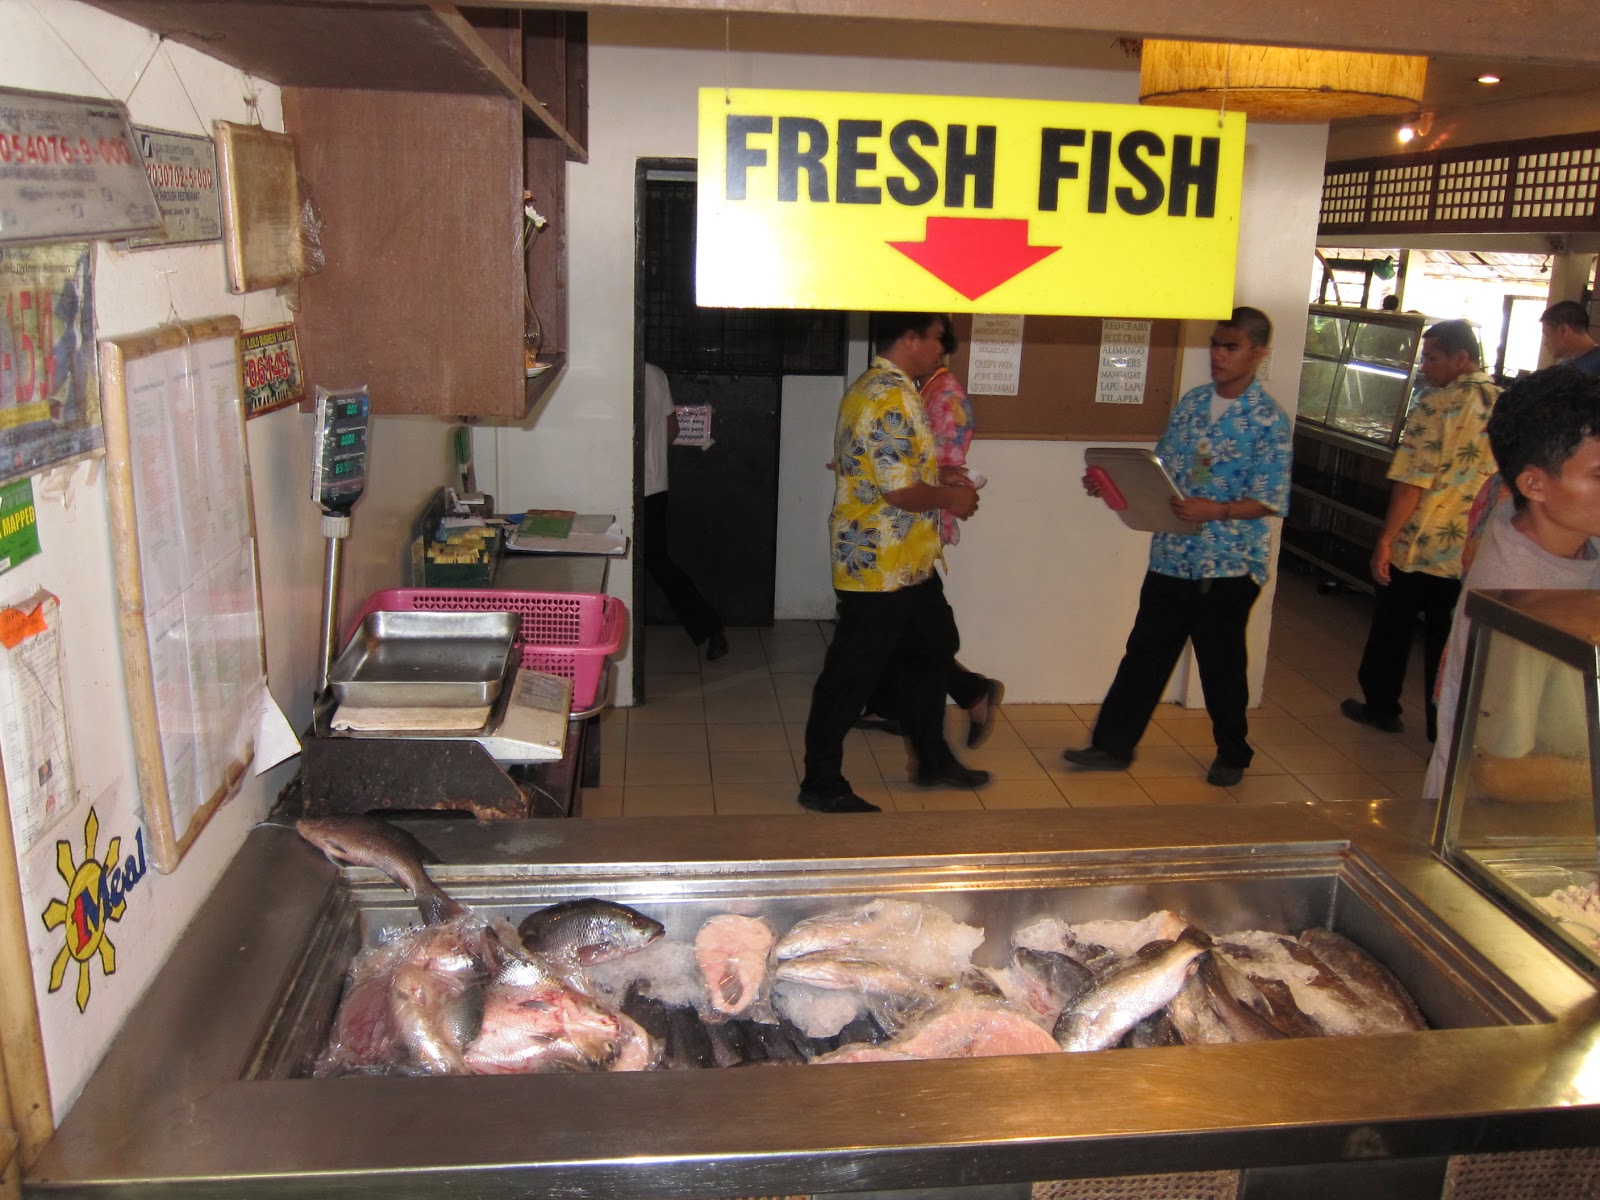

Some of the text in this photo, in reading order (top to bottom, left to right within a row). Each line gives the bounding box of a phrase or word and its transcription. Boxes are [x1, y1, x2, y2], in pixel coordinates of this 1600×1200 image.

[725, 114, 1221, 218] FRESH FISH
[1104, 321, 1149, 332] RED CRABS
[1104, 334, 1146, 344] BLUE CRABS
[1103, 347, 1145, 355] ALIMANGO
[1100, 371, 1142, 380] MANGAGAT
[1100, 394, 1140, 403] TILAPIA
[2, 505, 36, 537] MAPPED
[81, 826, 147, 936] Meal
